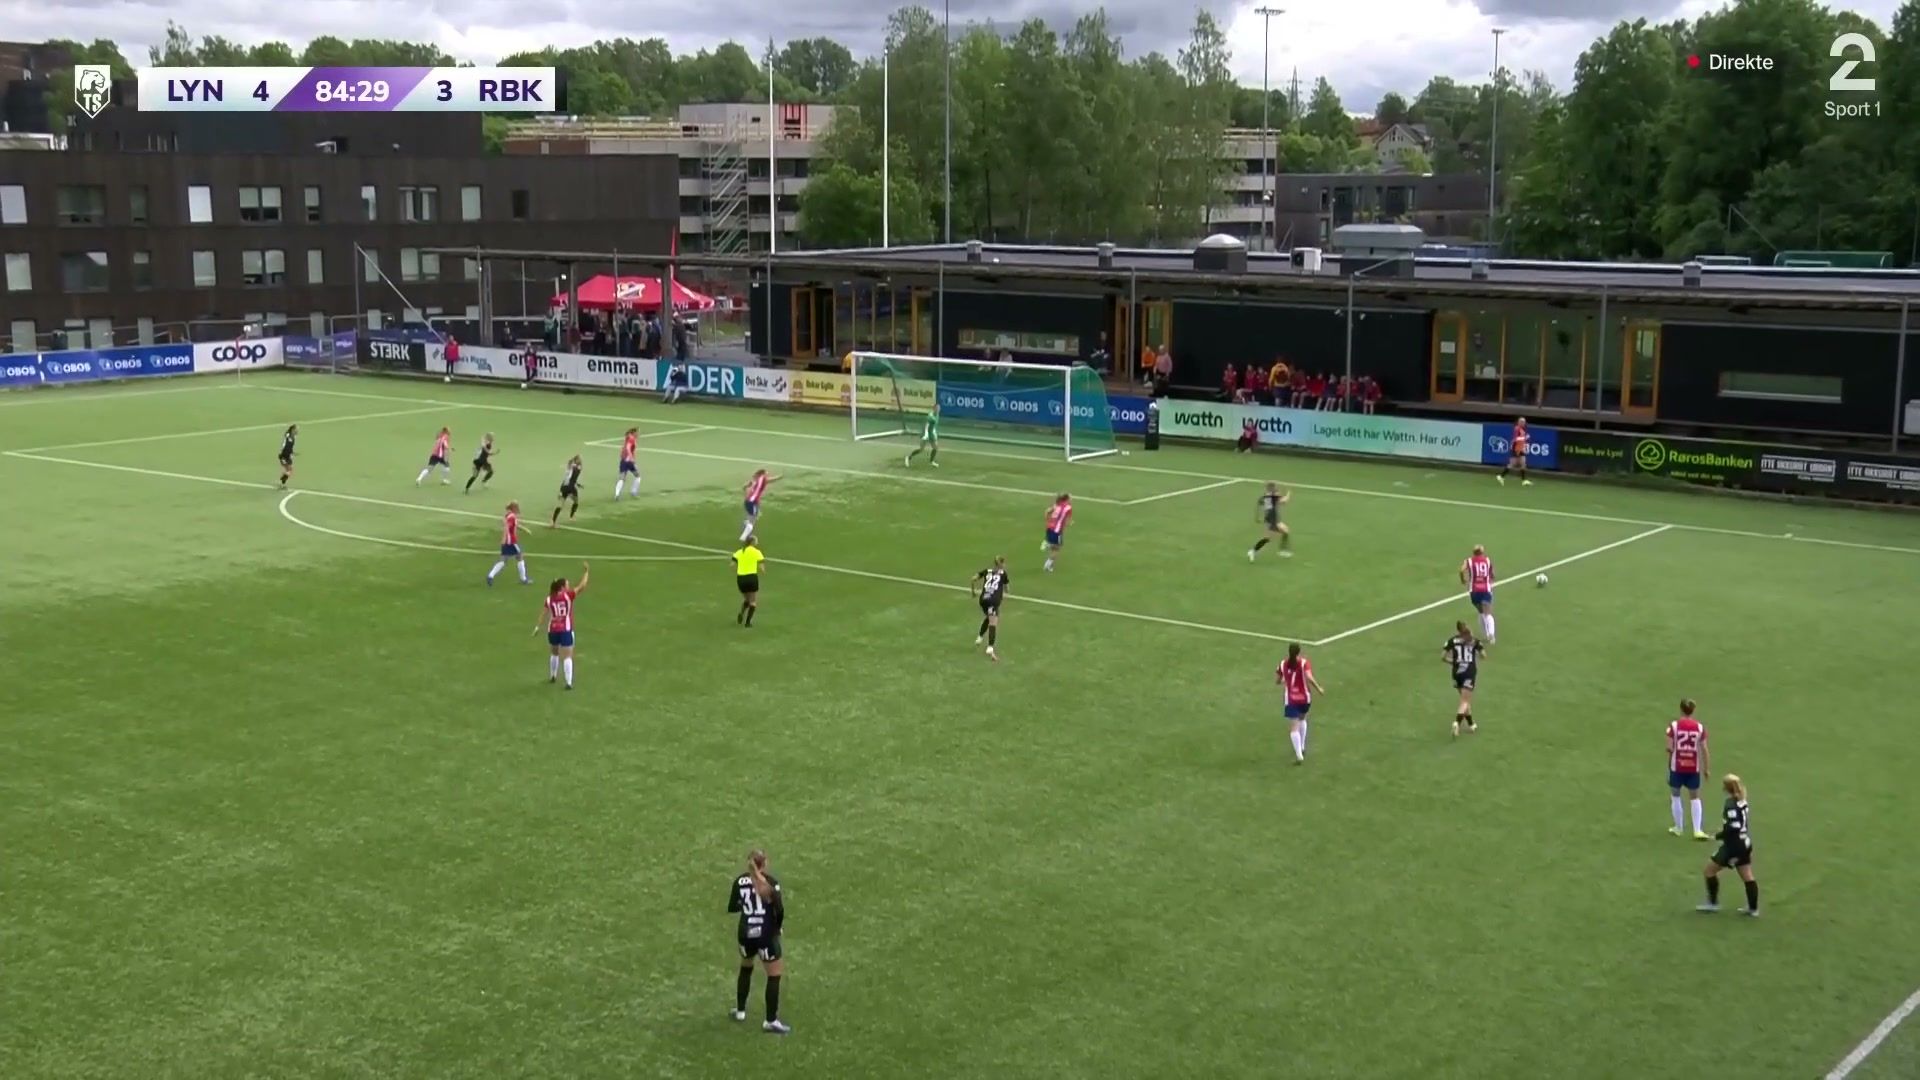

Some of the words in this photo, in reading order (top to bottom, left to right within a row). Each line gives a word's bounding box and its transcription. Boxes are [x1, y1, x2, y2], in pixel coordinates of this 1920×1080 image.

[164, 355, 190, 366] OBOS
[212, 344, 267, 363] coop
[6, 365, 36, 376] OBOS
[63, 362, 91, 373] OBOS
[114, 358, 142, 369] OBOS
[587, 358, 639, 375] emma
[956, 397, 985, 409] OBOS
[1010, 400, 1039, 413] OBOS
[1121, 410, 1145, 422] OBO
[1174, 411, 1224, 428] wattn
[1242, 416, 1292, 434] wattn
[1313, 424, 1341, 438] Laget
[1344, 427, 1361, 439] ditt
[1364, 429, 1379, 440] har
[1383, 431, 1418, 443] Wattn.
[1420, 435, 1438, 445] Har
[1441, 436, 1461, 447] du?
[1669, 450, 1753, 469] RørosBanken
[1475, 562, 1488, 577] 19
[552, 602, 567, 616] 16
[1677, 731, 1699, 750] 23
[740, 888, 766, 915] 31
